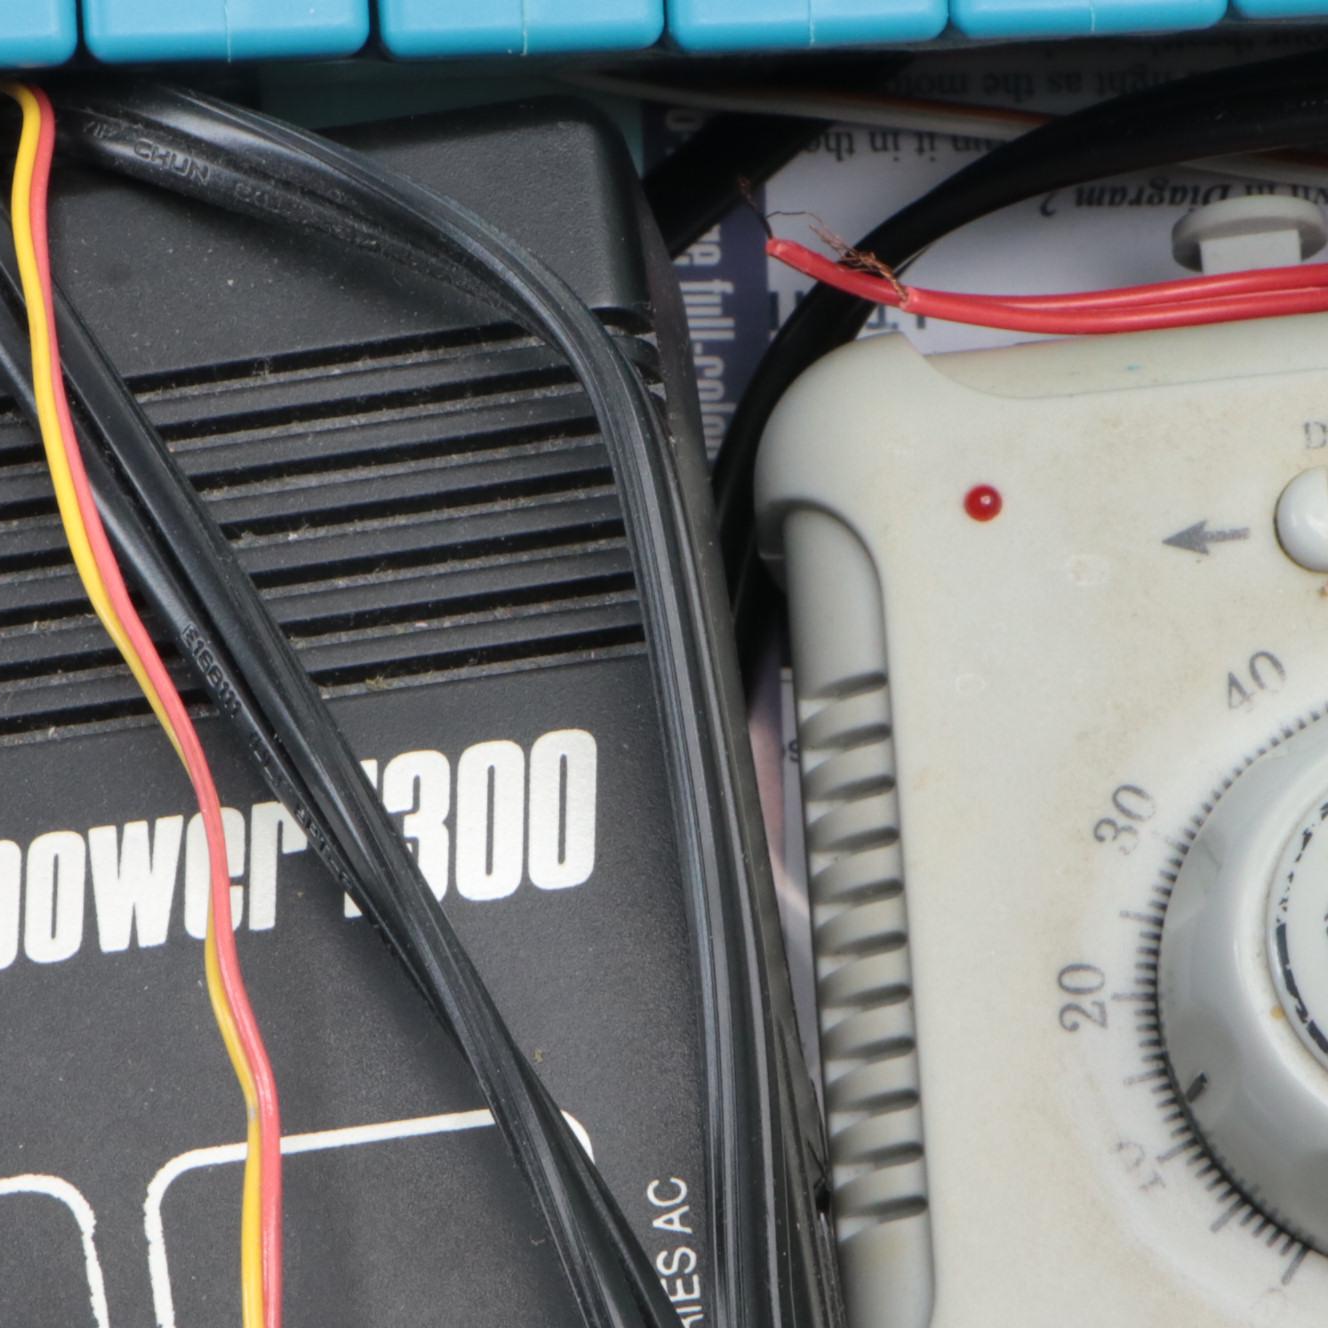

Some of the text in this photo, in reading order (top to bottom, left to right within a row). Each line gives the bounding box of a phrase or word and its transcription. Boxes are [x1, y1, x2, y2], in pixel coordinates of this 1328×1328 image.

[1075, 174, 1233, 211] Diagram
[1225, 650, 1287, 712] 40
[1092, 783, 1158, 856] 30
[1057, 962, 1109, 1034] 20
[647, 1177, 693, 1235] AC
